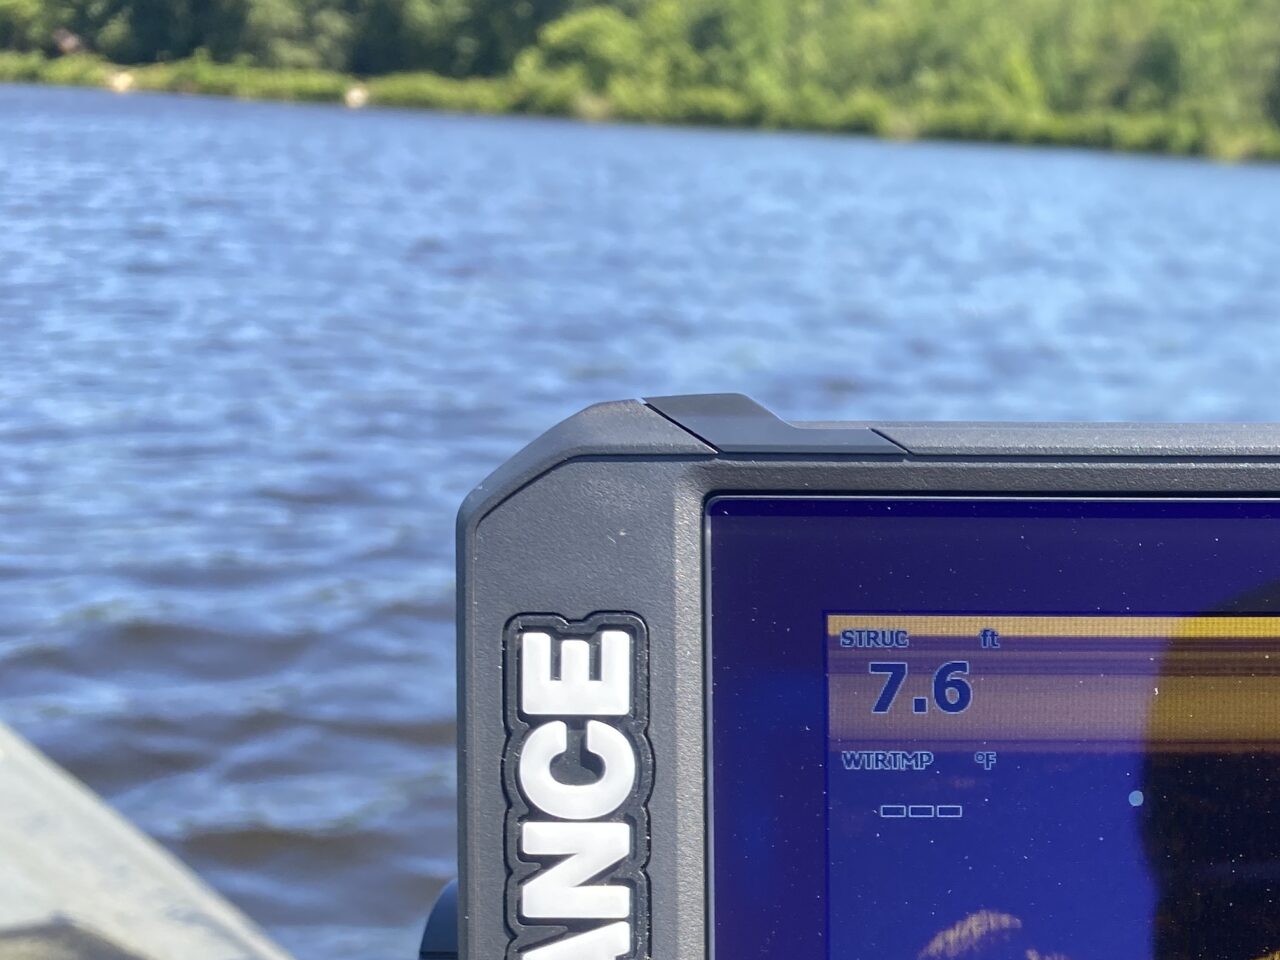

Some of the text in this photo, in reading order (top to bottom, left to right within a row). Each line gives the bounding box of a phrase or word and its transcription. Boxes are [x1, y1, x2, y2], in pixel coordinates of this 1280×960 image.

[840, 628, 1000, 649] STRUC ft
[868, 660, 973, 714] 7.6
